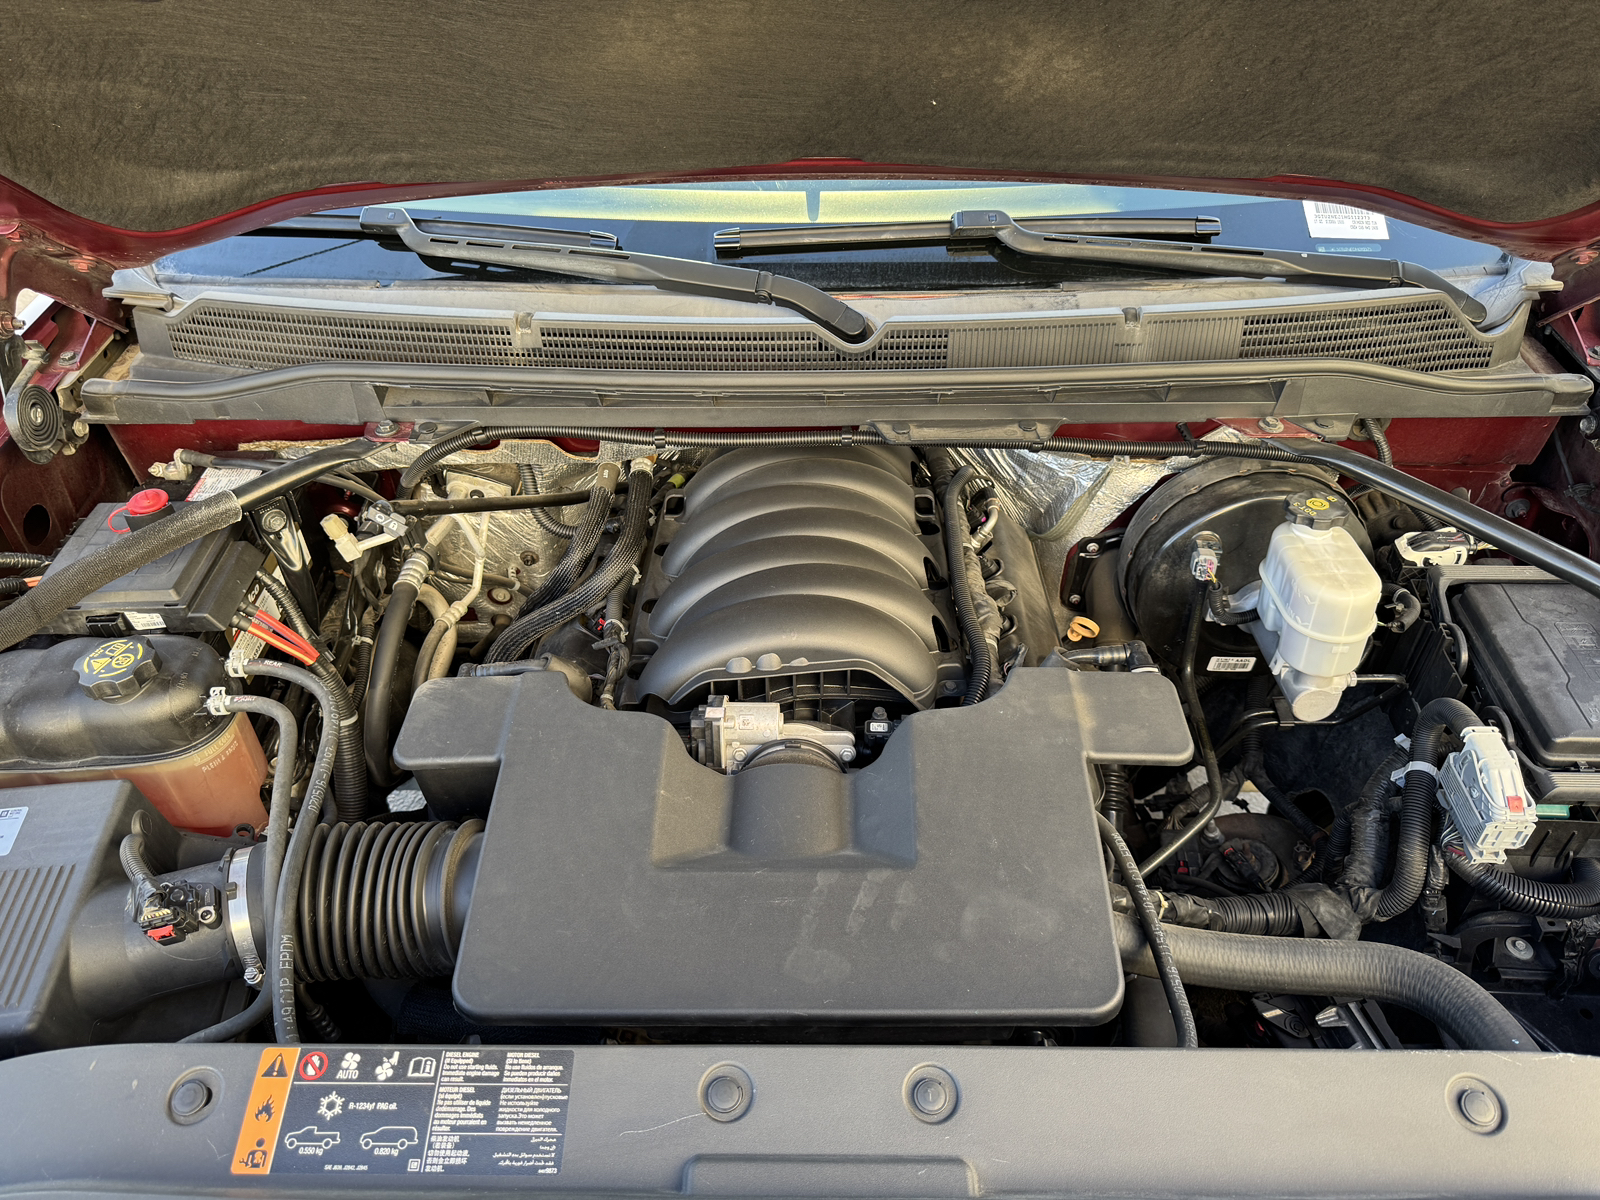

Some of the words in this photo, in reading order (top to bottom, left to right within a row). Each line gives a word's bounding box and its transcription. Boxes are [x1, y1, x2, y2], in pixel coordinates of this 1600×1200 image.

[280, 934, 294, 970] EPDM
[336, 1070, 359, 1079] AUTO
[348, 1102, 375, 1112] R-1234yf
[376, 1102, 388, 1110] PAG
[316, 1147, 324, 1156] kg
[391, 1148, 399, 1156] kg
